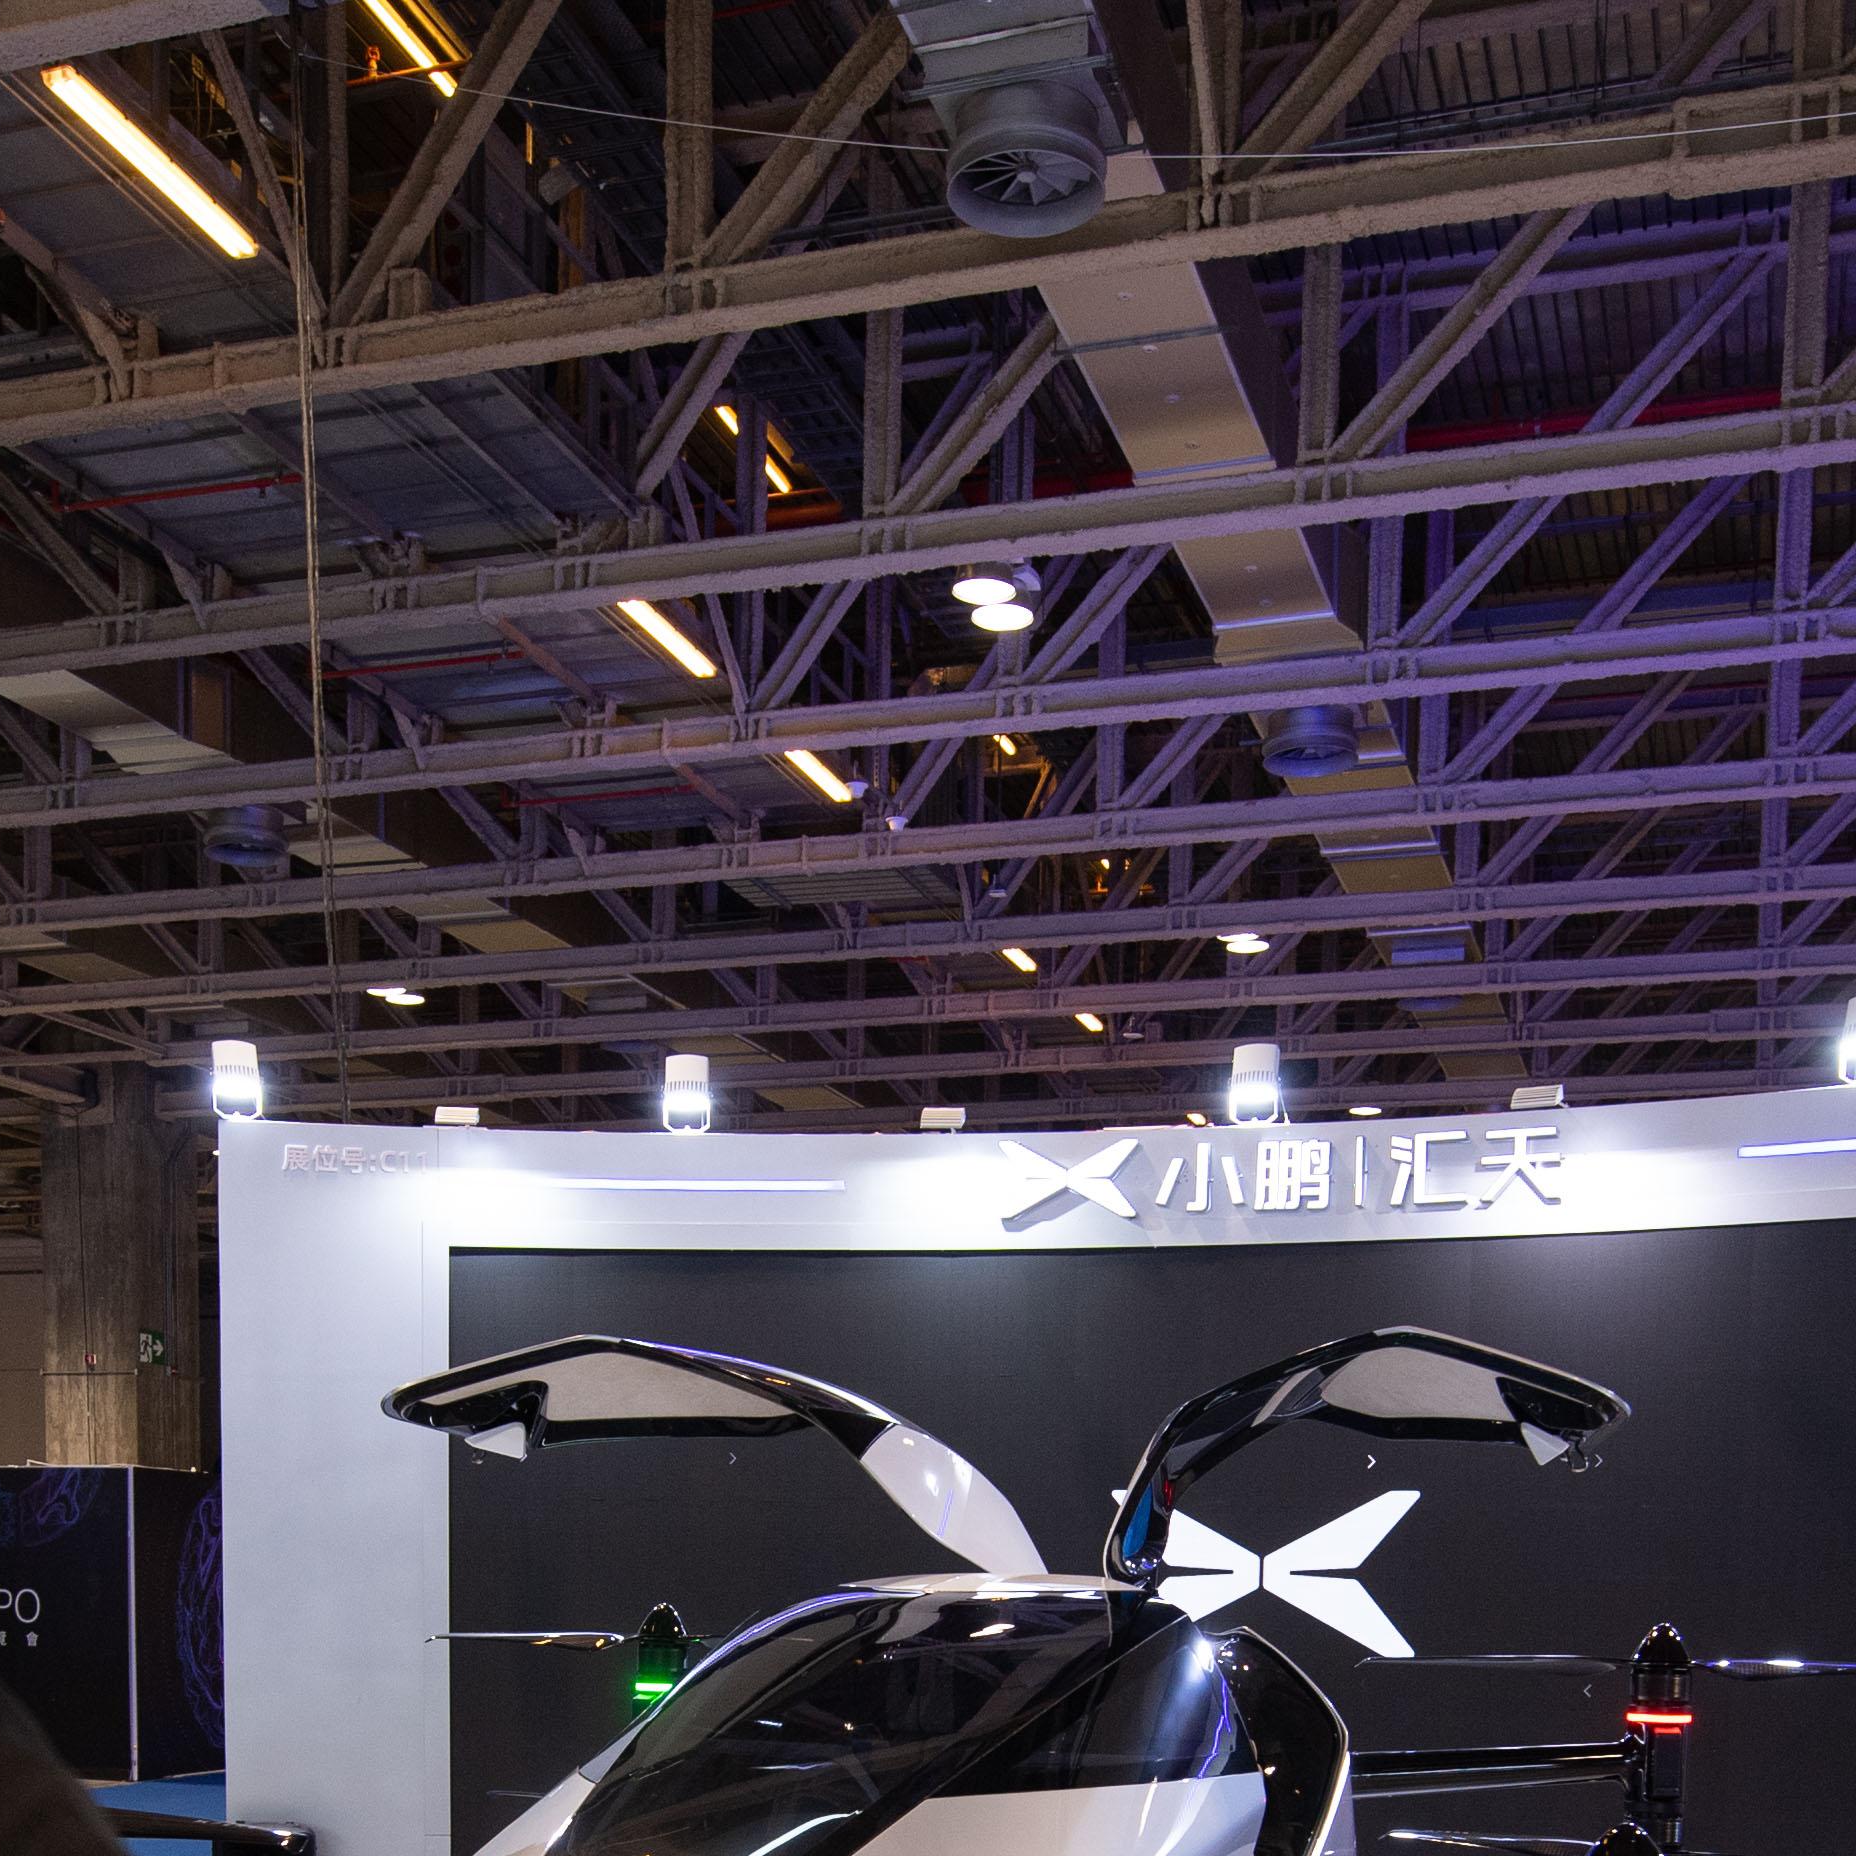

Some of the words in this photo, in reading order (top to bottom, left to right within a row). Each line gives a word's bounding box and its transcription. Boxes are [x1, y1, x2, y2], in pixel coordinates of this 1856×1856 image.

[281, 1143, 428, 1174] 展位号:C11
[1155, 1140, 1332, 1212] 小鹏
[1390, 1126, 1562, 1210] 汇天
